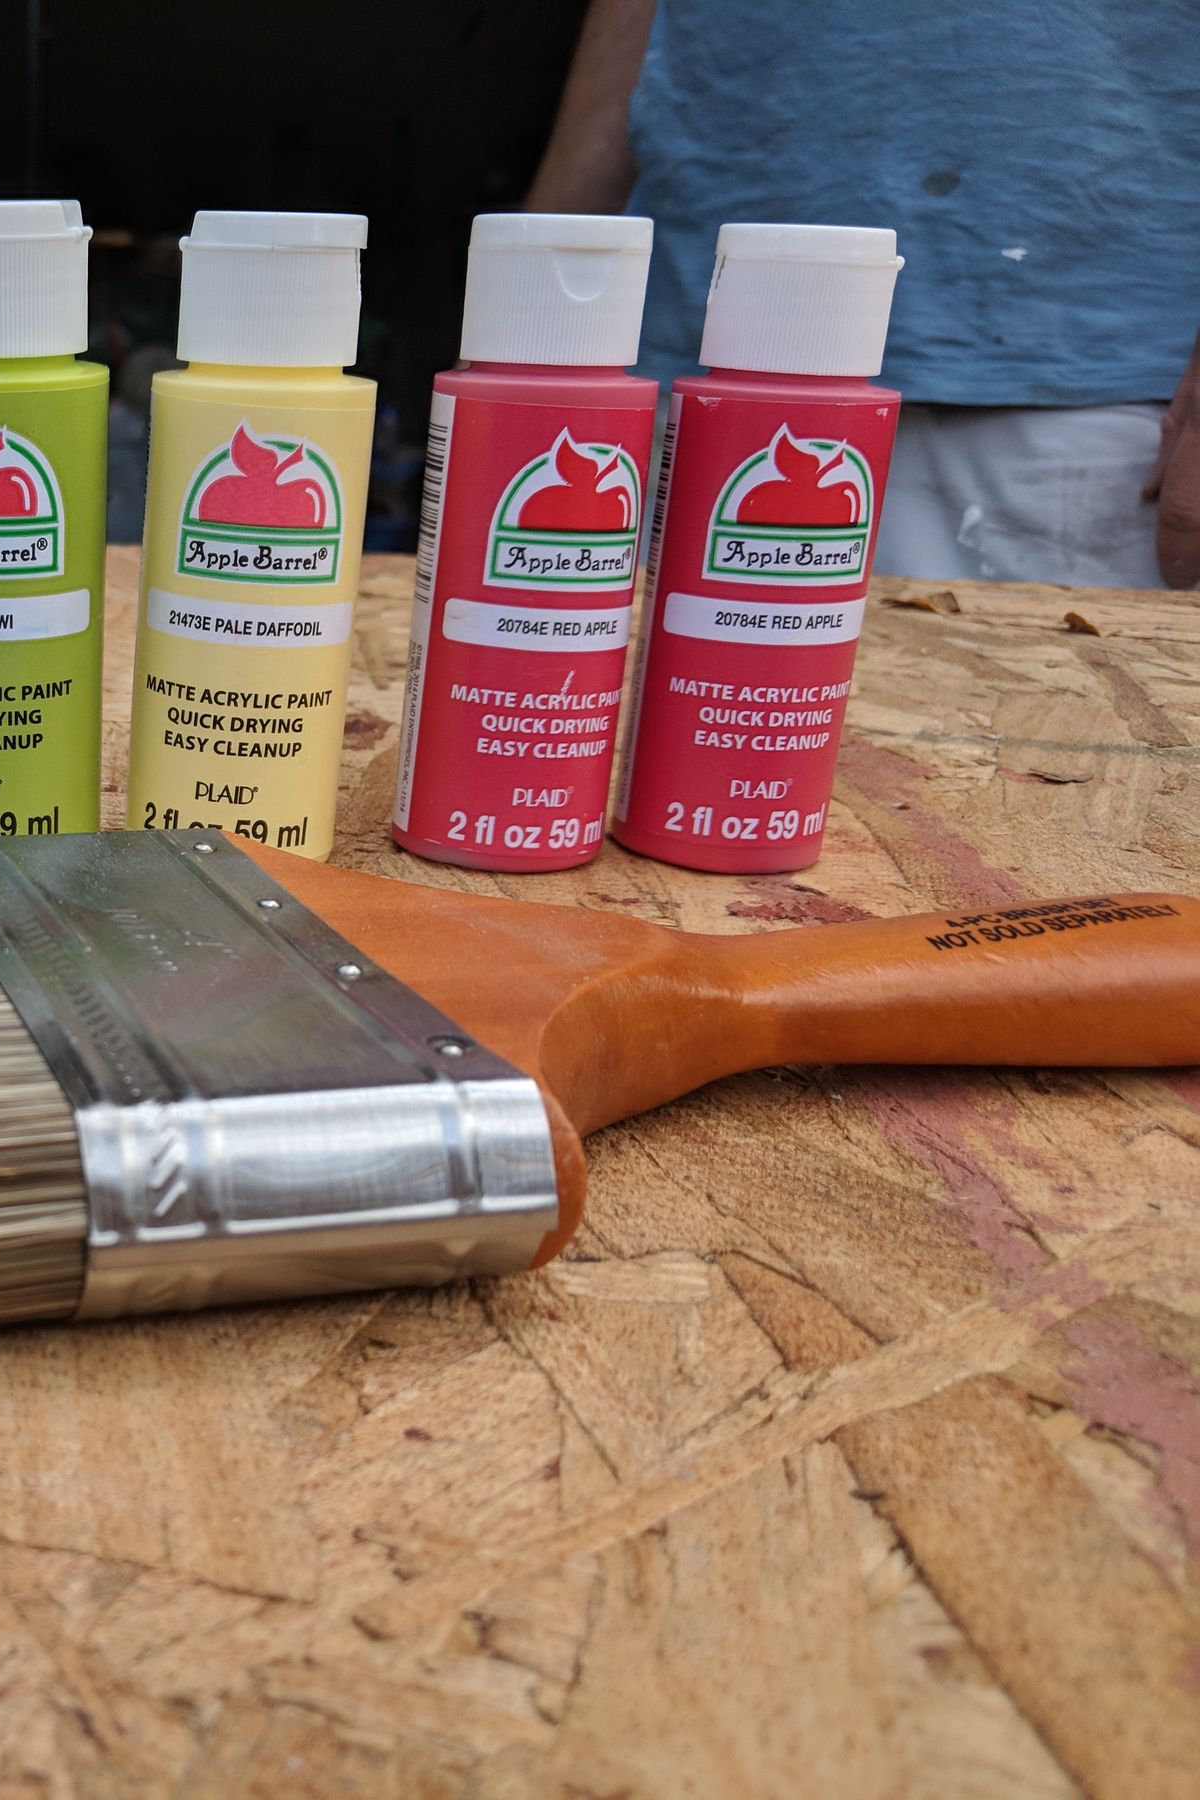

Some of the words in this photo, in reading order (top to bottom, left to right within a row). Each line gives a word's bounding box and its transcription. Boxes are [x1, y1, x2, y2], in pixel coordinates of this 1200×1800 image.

[186, 540, 249, 570] Apple
[504, 546, 570, 574] Apple
[722, 540, 790, 568] Apple
[169, 610, 211, 631] 21473E
[214, 618, 252, 636] PALE
[256, 622, 322, 637] DAFFODIL
[497, 618, 549, 635] 20784E
[552, 622, 581, 636] RED
[584, 620, 618, 636] APPLE
[715, 611, 768, 628] 20784E
[772, 615, 802, 630] RED
[805, 614, 844, 630] APPLE
[22, 679, 72, 700] PAINT
[146, 674, 196, 702] MATTE
[200, 688, 283, 710] ACRYLIC
[287, 690, 332, 709] PAINT
[450, 684, 518, 708] MATTE
[520, 692, 598, 710] ACRYLIC
[669, 676, 735, 700] MATTE
[738, 686, 819, 704] ACRYLIC
[408, 693, 418, 717] PLAID
[699, 706, 764, 727] QUICK
[768, 708, 832, 727] DRYING
[167, 707, 226, 730] QUICK
[230, 717, 304, 734] DRYING
[482, 714, 548, 734] QUICK
[550, 716, 610, 734] DRYING
[164, 730, 209, 752] EASY
[213, 740, 302, 758] CLEANUP
[476, 738, 530, 757] EASY
[533, 740, 607, 759] CLEANUP
[694, 730, 748, 750] EASY
[751, 732, 830, 752] CLEANUP
[28, 806, 59, 836] ml
[144, 802, 157, 830] 2
[234, 820, 269, 844] 59
[277, 816, 308, 848] ml
[448, 810, 467, 841] 2
[475, 815, 496, 845] fl
[504, 825, 542, 849] oz
[548, 818, 580, 849] 59
[583, 811, 604, 846] ml
[664, 802, 684, 832] 2
[692, 806, 713, 836] fl
[721, 816, 760, 840] oz
[766, 810, 800, 841] 59
[803, 802, 826, 837] ml
[994, 903, 1077, 921] BRUSH
[926, 930, 980, 952] NOT
[978, 921, 1046, 942] SOLD
[1040, 904, 1180, 932] SEPARATELY
